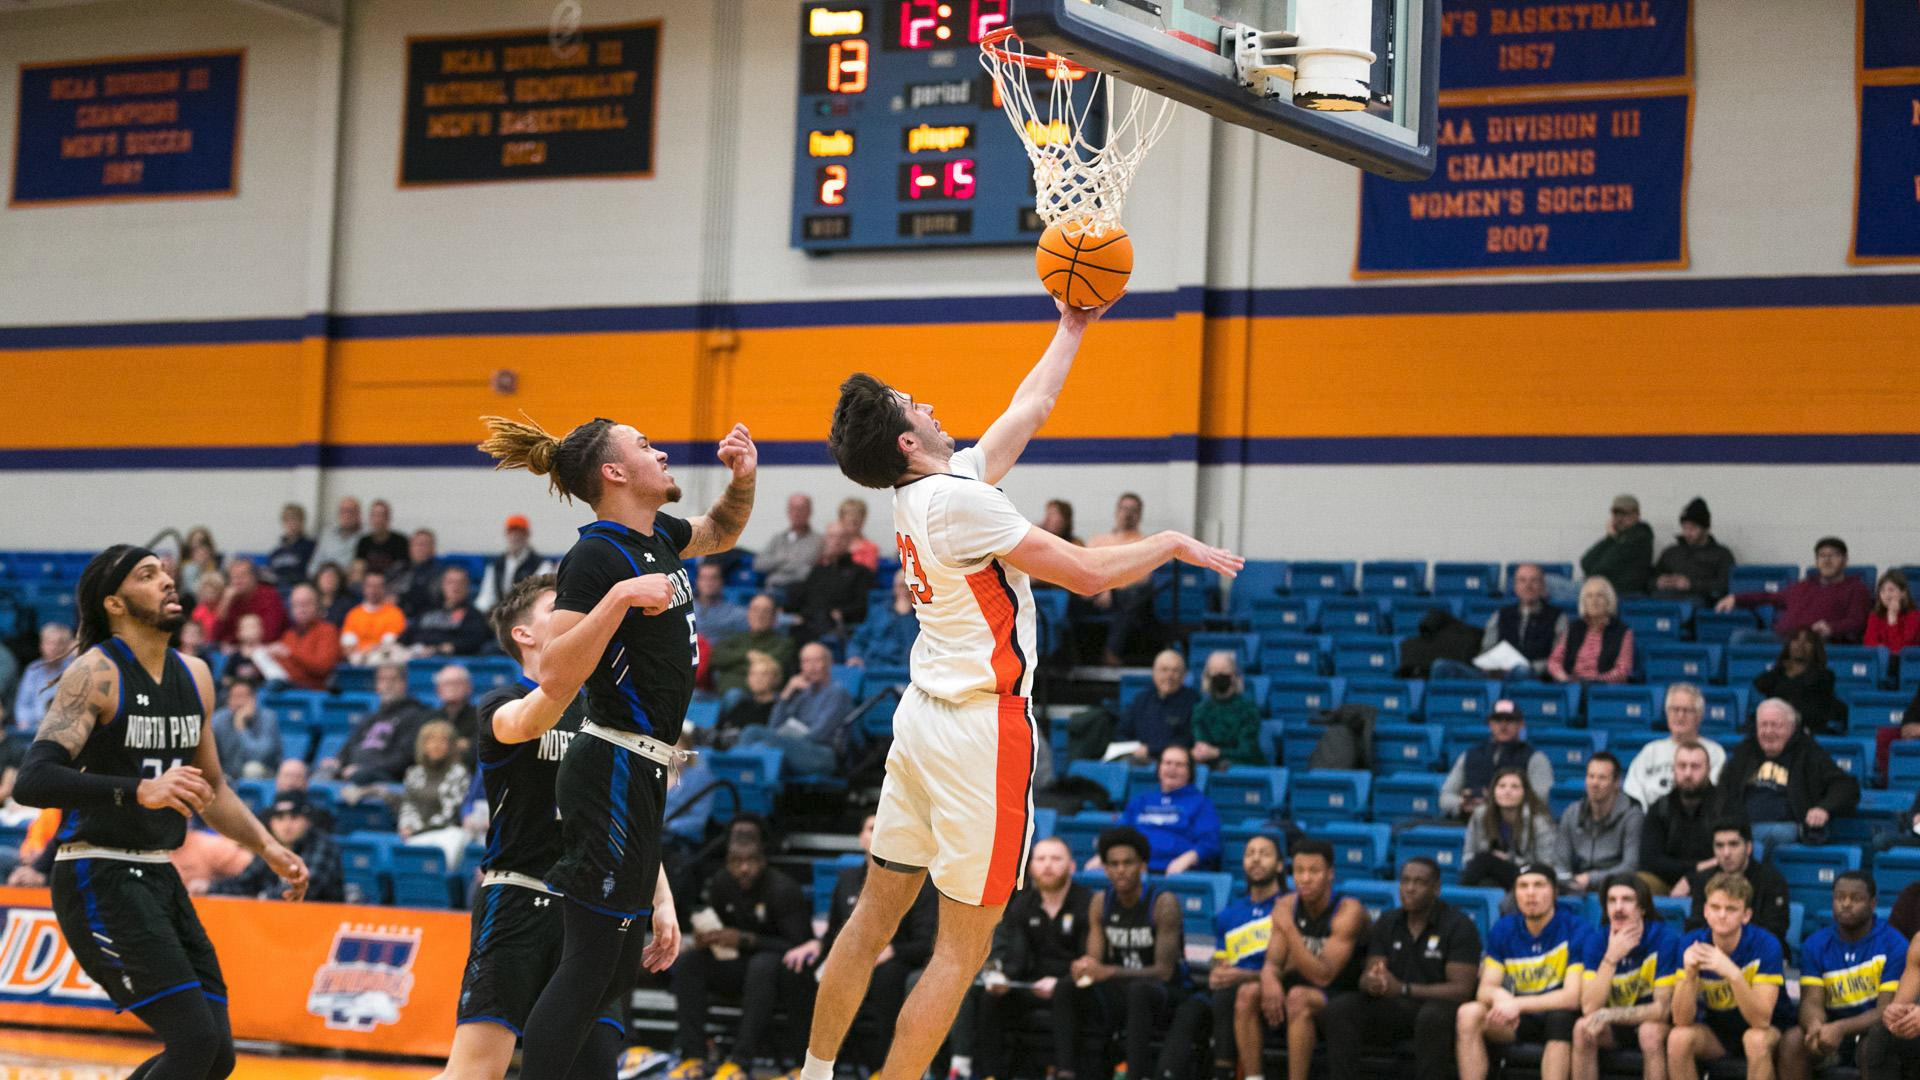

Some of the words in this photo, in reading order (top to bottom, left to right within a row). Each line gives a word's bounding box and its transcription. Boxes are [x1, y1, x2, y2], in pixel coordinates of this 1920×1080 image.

[1442, 12, 1478, 37] N'S
[1490, 2, 1657, 34] BASKETBALL
[827, 39, 869, 94] 13
[911, 80, 972, 107] period
[1437, 118, 1475, 145] AA
[1487, 112, 1598, 143] DIVISION
[1610, 110, 1641, 137] III
[1447, 148, 1596, 183] CHAMPIONS
[821, 164, 848, 206] 2
[1408, 188, 1525, 220] WOMEN'S
[1537, 184, 1633, 214] SOCCER
[1486, 223, 1549, 253] 2007
[124, 714, 166, 749] NORTH
[537, 729, 577, 761] NOR
